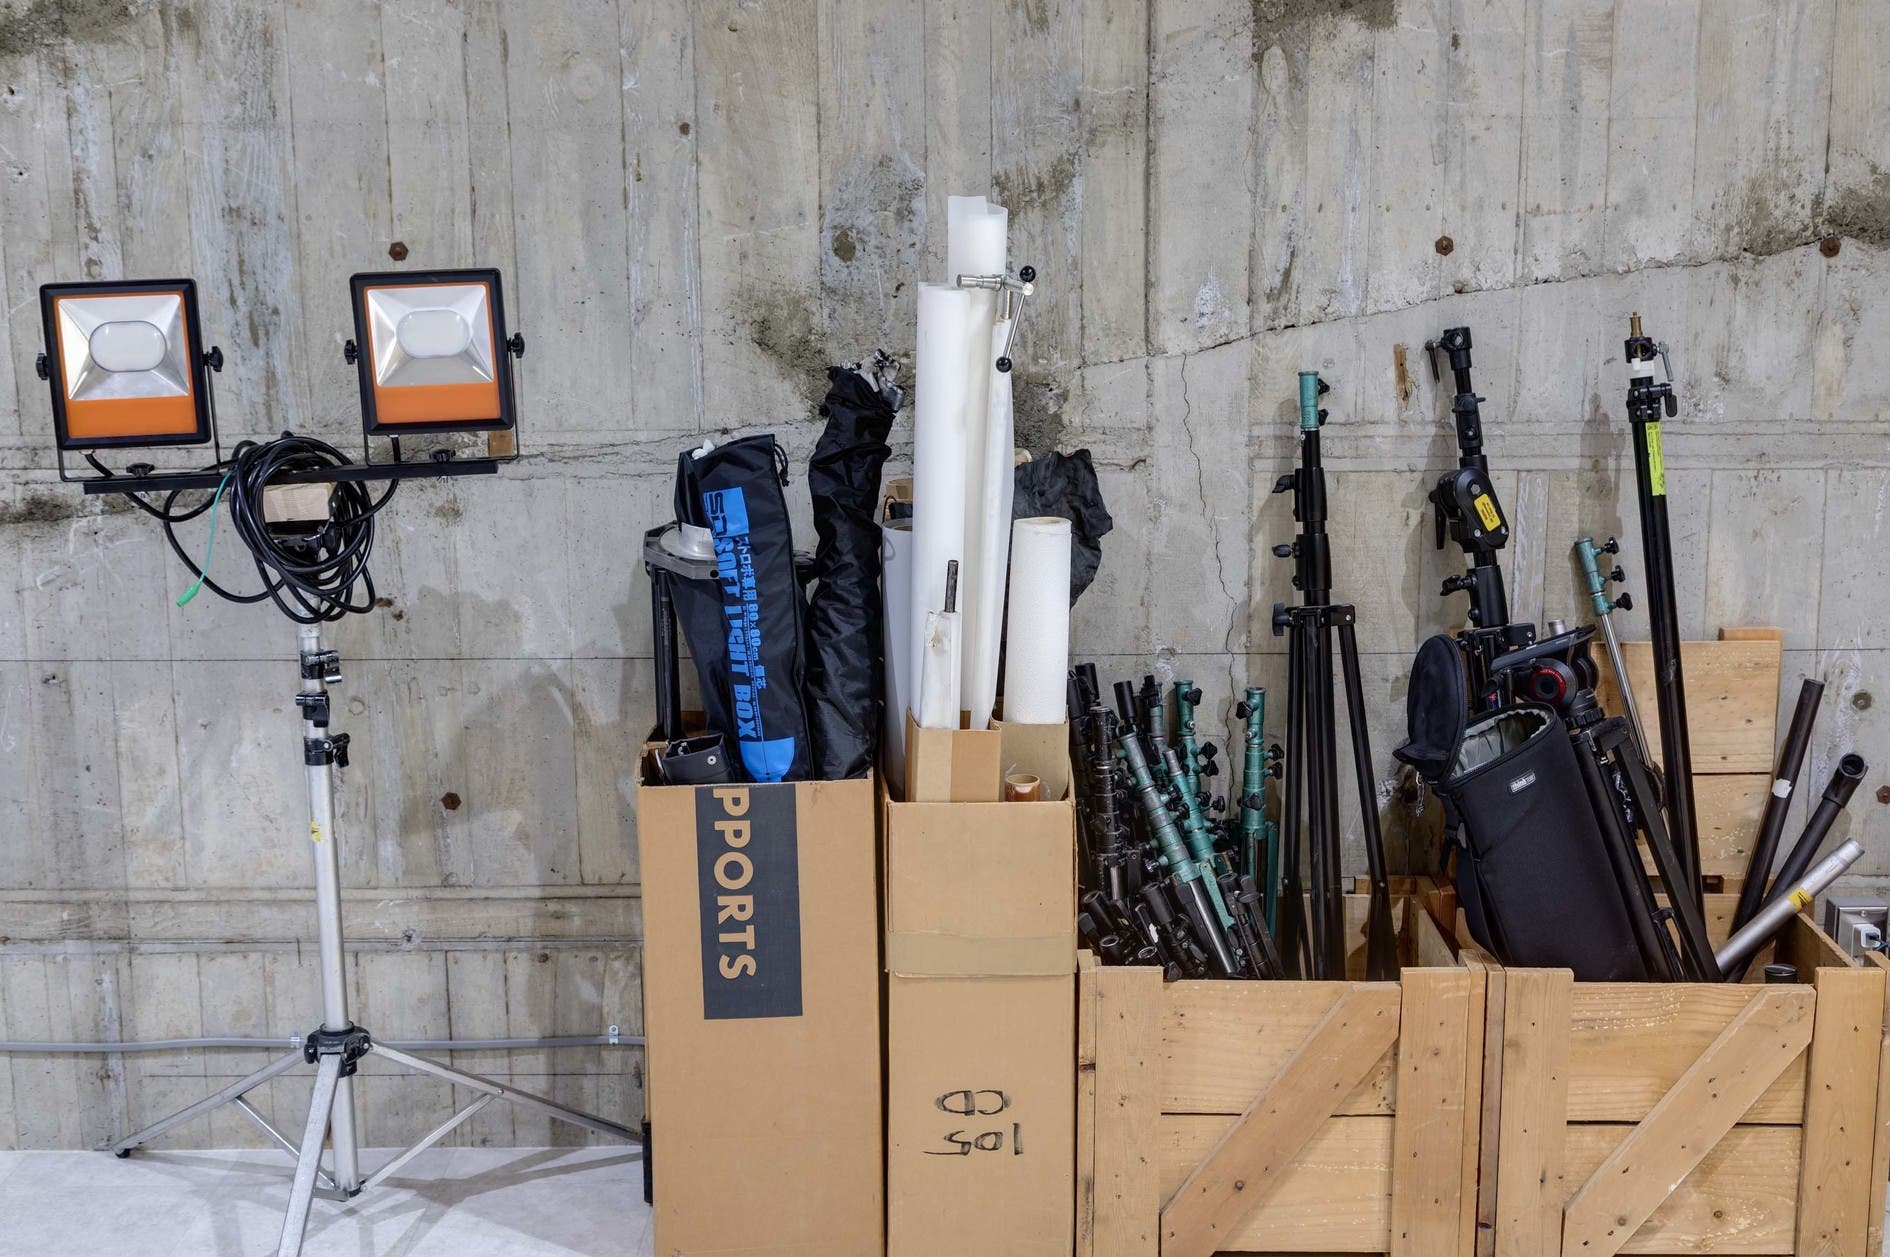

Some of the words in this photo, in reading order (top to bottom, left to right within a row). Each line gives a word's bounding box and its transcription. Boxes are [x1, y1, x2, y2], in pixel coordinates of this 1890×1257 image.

[713, 537, 740, 598] SOFT
[725, 605, 750, 677] LIGHT
[734, 685, 758, 738] BOX
[712, 788, 757, 978] PPORTS
[934, 1089, 1011, 1116] CD
